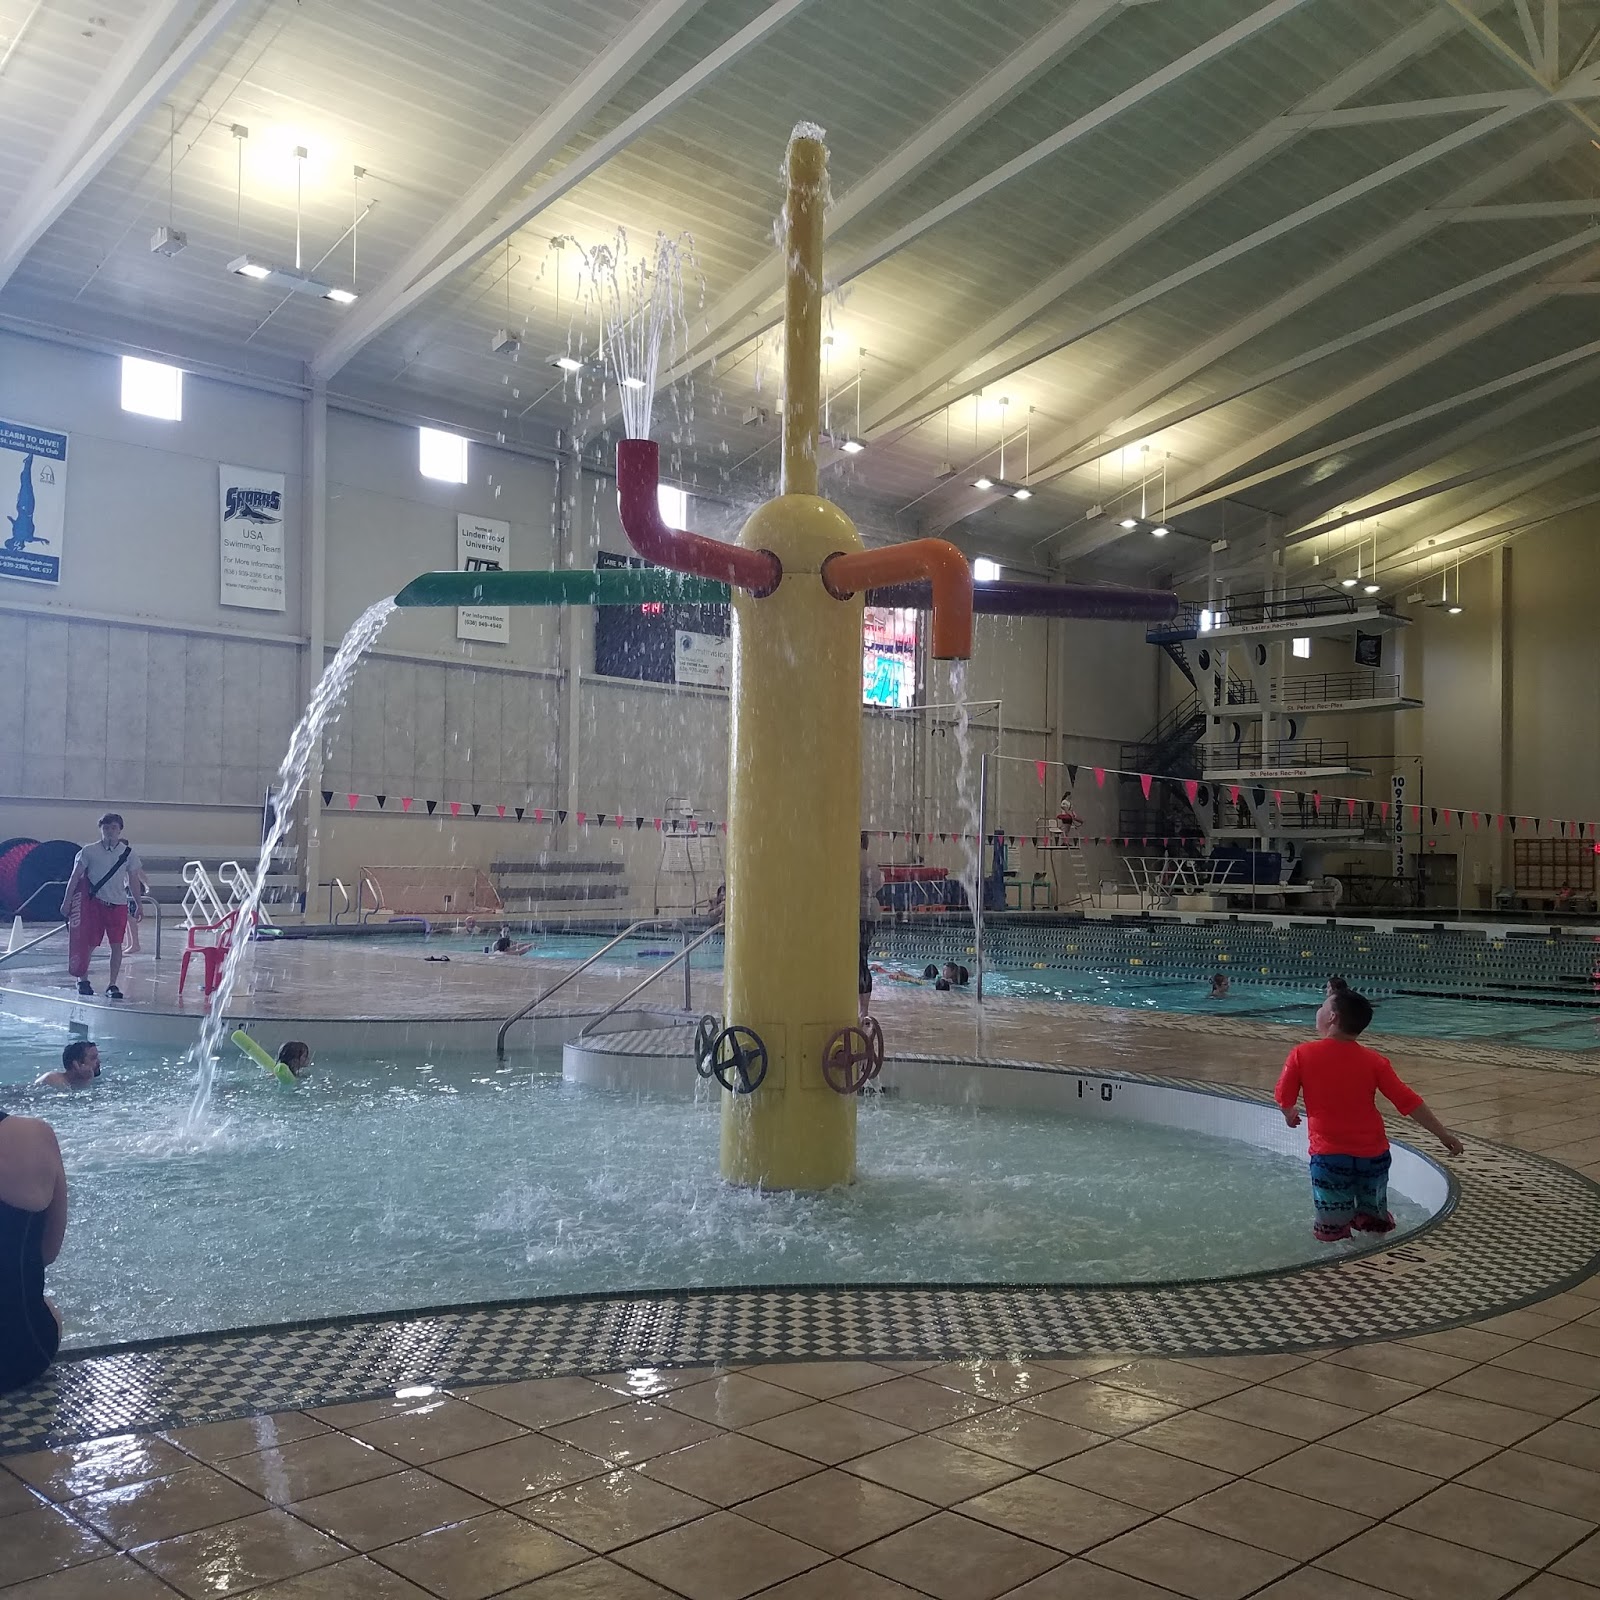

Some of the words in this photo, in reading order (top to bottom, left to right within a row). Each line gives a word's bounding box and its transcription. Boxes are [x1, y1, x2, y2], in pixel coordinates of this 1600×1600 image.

[0, 429, 26, 441] LEARN
[27, 434, 37, 443] TO
[39, 437, 60, 449] DIVE!
[9, 439, 25, 448] Louis
[26, 443, 45, 453] Diving
[46, 447, 59, 455] Club
[242, 529, 264, 541] USA
[461, 529, 505, 543] Lindenwood
[223, 538, 261, 552] Swimming
[262, 543, 281, 553] Team
[465, 539, 502, 553] University
[223, 555, 234, 563] For
[234, 557, 250, 566] More
[1392, 777, 1405, 787] 10
[1395, 788, 1403, 798] 9
[1395, 821, 1403, 832] 6
[1396, 855, 1404, 865] 3
